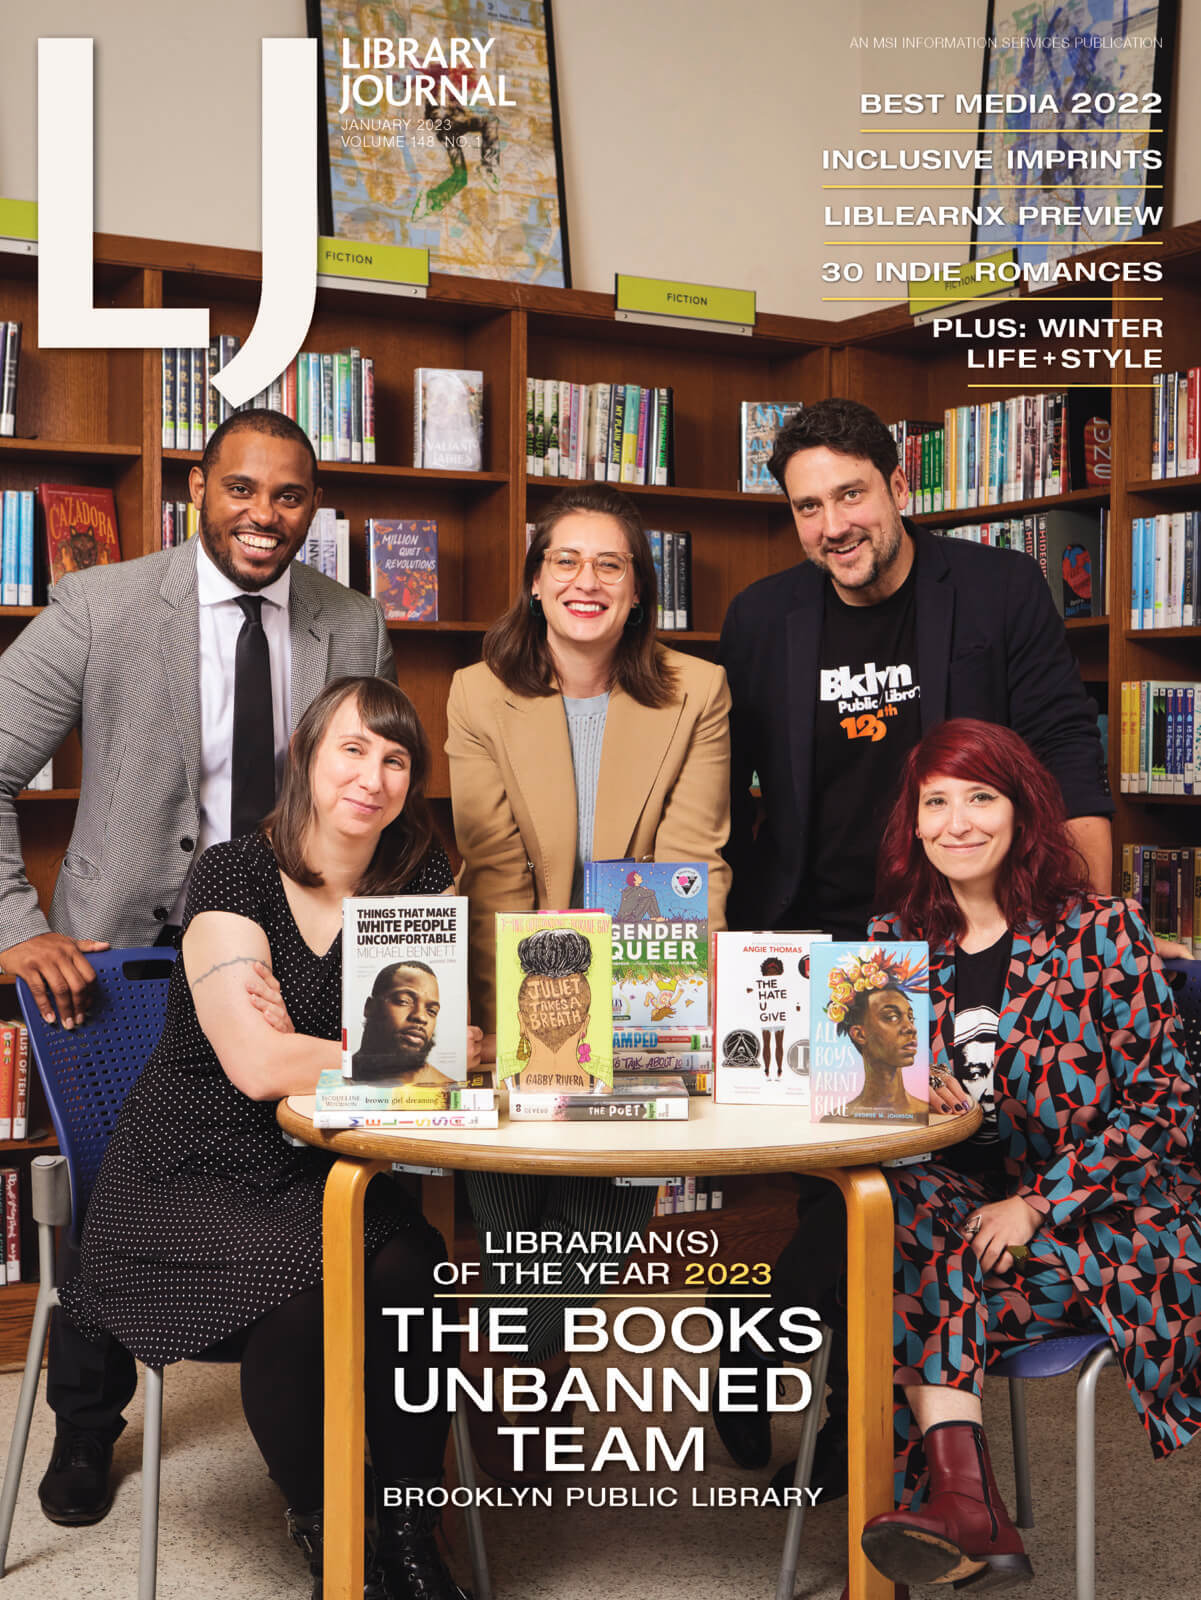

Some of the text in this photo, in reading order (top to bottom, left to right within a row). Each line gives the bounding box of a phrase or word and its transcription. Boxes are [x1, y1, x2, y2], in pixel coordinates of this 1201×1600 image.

[325, 250, 373, 265] FICTION
[666, 292, 708, 306] FICTION
[49, 496, 116, 544] CAZADORA
[397, 522, 403, 530] A
[381, 533, 419, 545] MILLION
[399, 546, 421, 556] QUIET
[384, 559, 436, 570] REVOLUTIONS
[820, 662, 913, 705] Bklyn
[838, 696, 879, 714] Public
[357, 907, 457, 919] THINGS THAT MAKE
[357, 919, 457, 933] WHITE PEOPLE
[611, 923, 699, 941] GENDER
[357, 933, 457, 945] UNCOMFORTABLE
[357, 944, 457, 959] MICHAEL BENNETT
[611, 941, 699, 961] QUEER
[527, 978, 581, 1001] JULIET
[756, 979, 778, 989] THE
[758, 989, 788, 1001] HATE
[529, 996, 582, 1014] TAKES A
[759, 1001, 768, 1011] U
[529, 1009, 581, 1030] BREATH
[759, 1011, 787, 1022] GIVE
[815, 1020, 838, 1043] ALL
[612, 1031, 658, 1049] AMPED
[622, 1055, 644, 1070] TALK
[645, 1055, 676, 1071] ABOUT
[815, 1045, 856, 1069] BOYS
[18, 1037, 29, 1097] LIST OF TEN
[525, 1073, 585, 1088] GABBY RIVERA
[365, 1094, 439, 1105] brown girl dreaming
[815, 1095, 849, 1117] BLUE
[588, 1106, 606, 1116] THE
